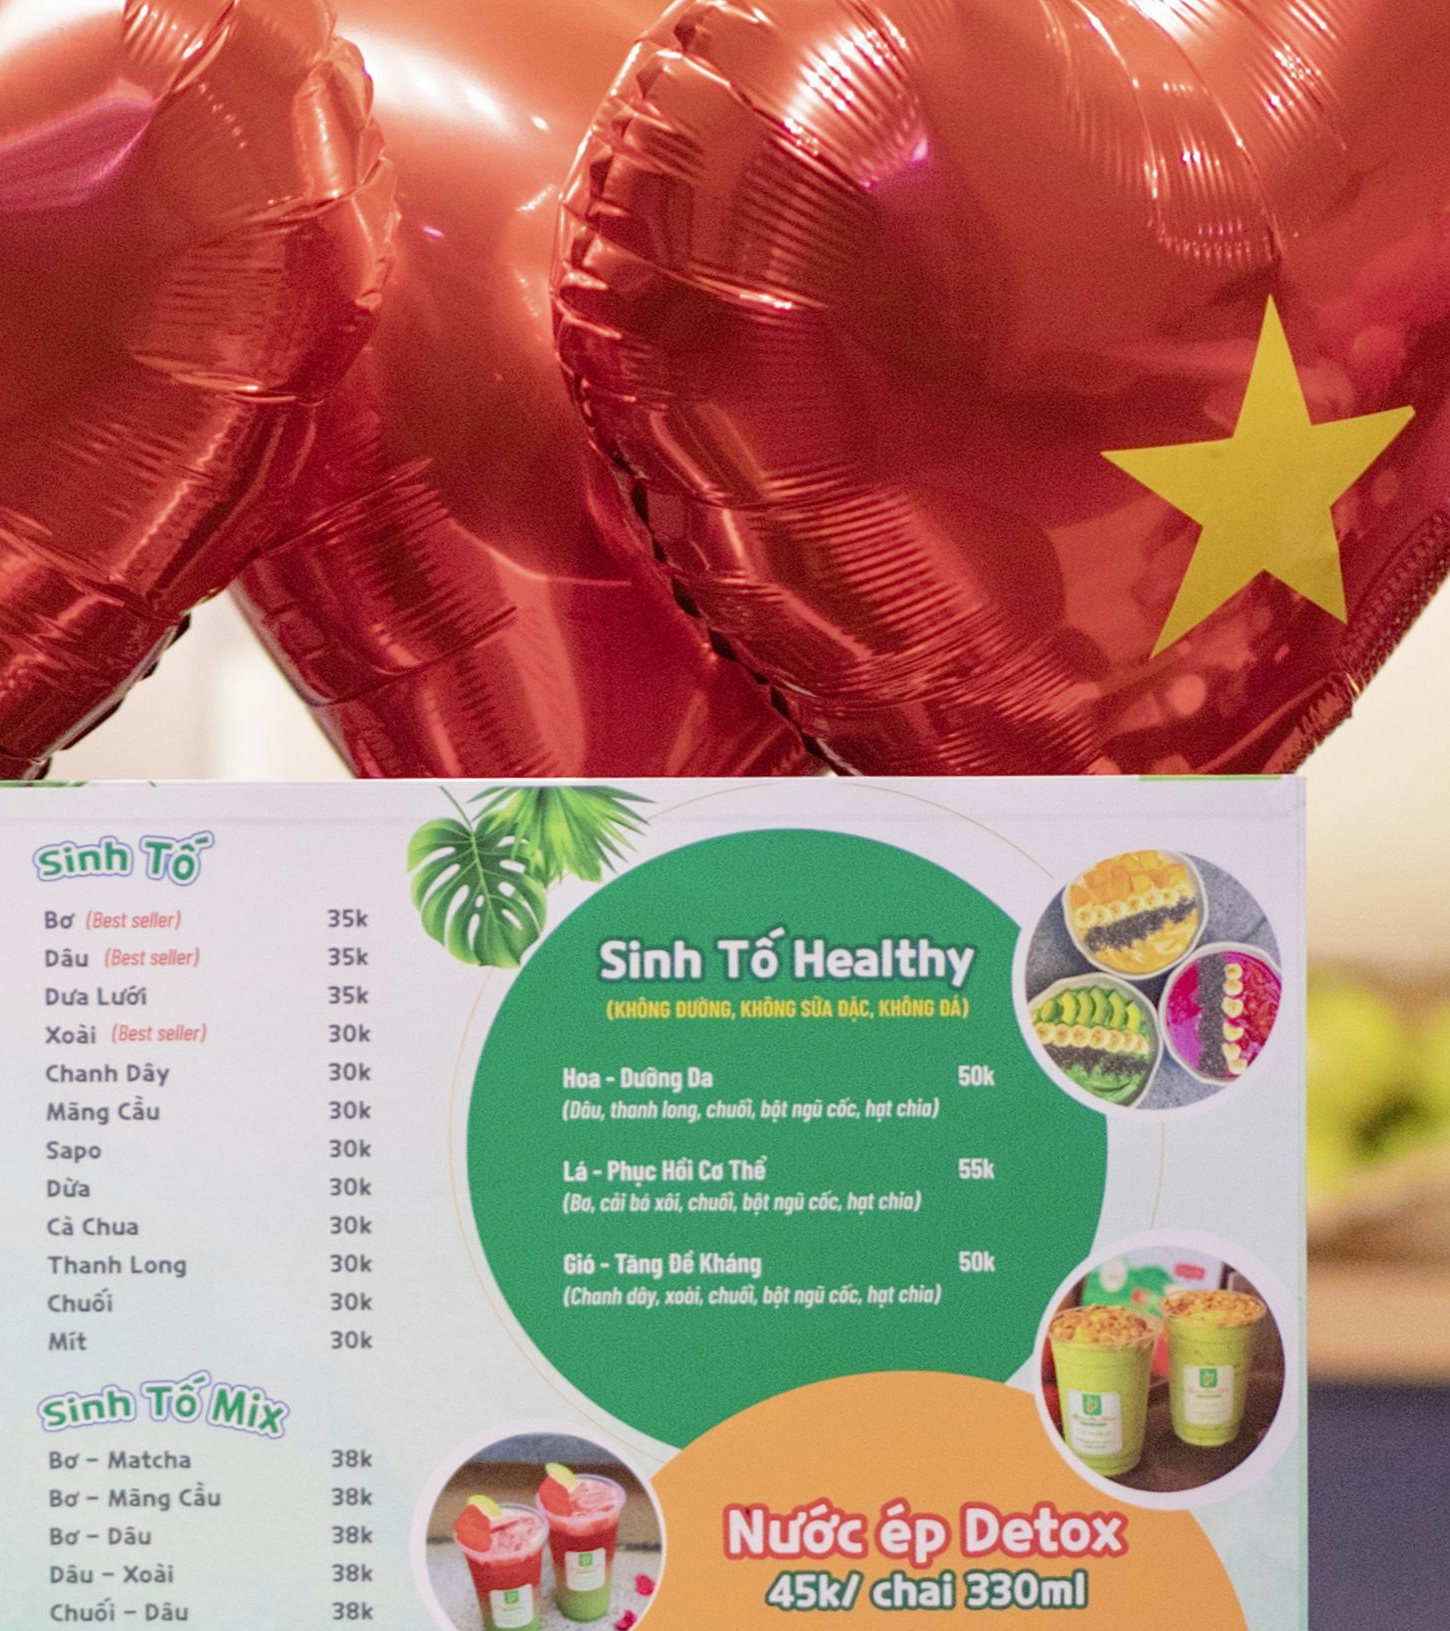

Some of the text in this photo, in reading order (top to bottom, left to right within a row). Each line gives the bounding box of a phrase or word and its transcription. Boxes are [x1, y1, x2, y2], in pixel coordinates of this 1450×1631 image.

[40, 837, 209, 881] Sinh Tố
[45, 909, 367, 930] Bơ (Best seller) 35k
[601, 928, 974, 986] Sinh Tố Healthy
[606, 996, 969, 1021] (KHÔNG ĐƯỜNG, KHÔNG SỮA ĐẶC, KHÔNG ĐÁ)
[45, 1023, 370, 1044] Xoài (Best seller) 30k
[958, 1065, 995, 1086] 50k
[47, 1096, 371, 1125] Mãng Cầu 30k
[46, 1139, 371, 1164] Sapo 30k
[959, 1158, 994, 1179] 55k
[48, 1254, 372, 1278] Thanh Long 30k
[959, 1251, 995, 1272] 50k
[47, 1288, 372, 1313] Chuối 30k
[48, 1331, 372, 1351] Mít 30k
[44, 1376, 284, 1433] Sinh Tố Mix
[730, 1504, 1121, 1562] Nước ép Detox
[769, 1573, 1084, 1607] 45k/ chai 330ml
